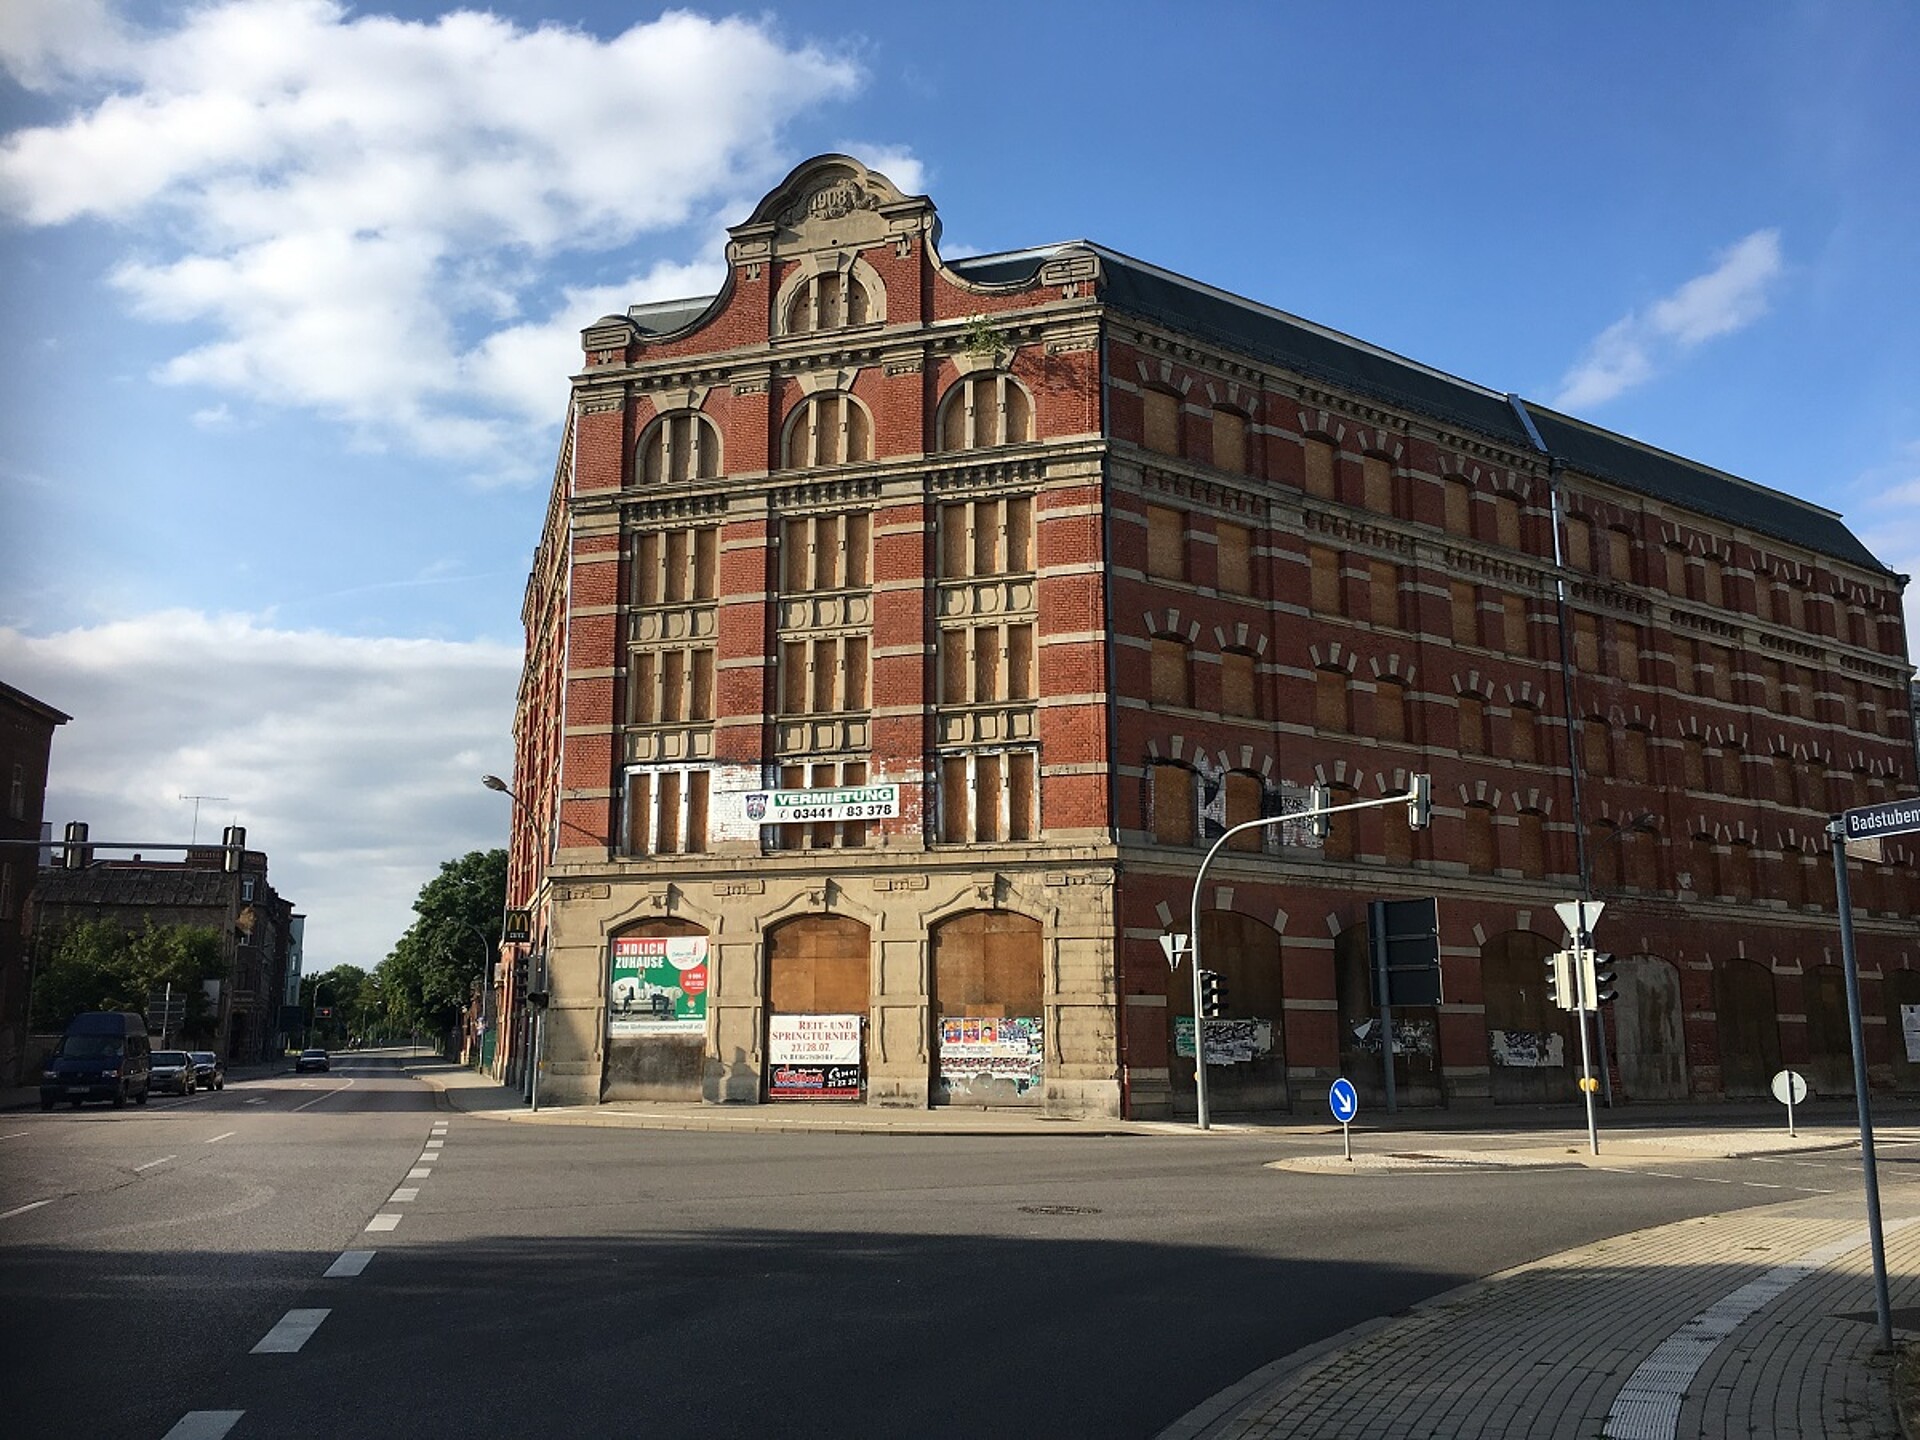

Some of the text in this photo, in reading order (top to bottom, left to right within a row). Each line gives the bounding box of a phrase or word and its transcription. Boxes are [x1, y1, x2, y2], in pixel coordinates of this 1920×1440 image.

[811, 191, 847, 210] 1908
[776, 789, 892, 806] VERMIETUNG
[793, 808, 833, 819] 03441
[846, 806, 864, 816] 83
[867, 804, 892, 815] 378
[1851, 808, 1920, 831] Badstuben
[615, 943, 665, 956] ENDLICH
[615, 956, 665, 969] ZUHAUSE
[799, 1020, 853, 1030] REIT- UND
[772, 1031, 858, 1041] SPRINGTURNIER
